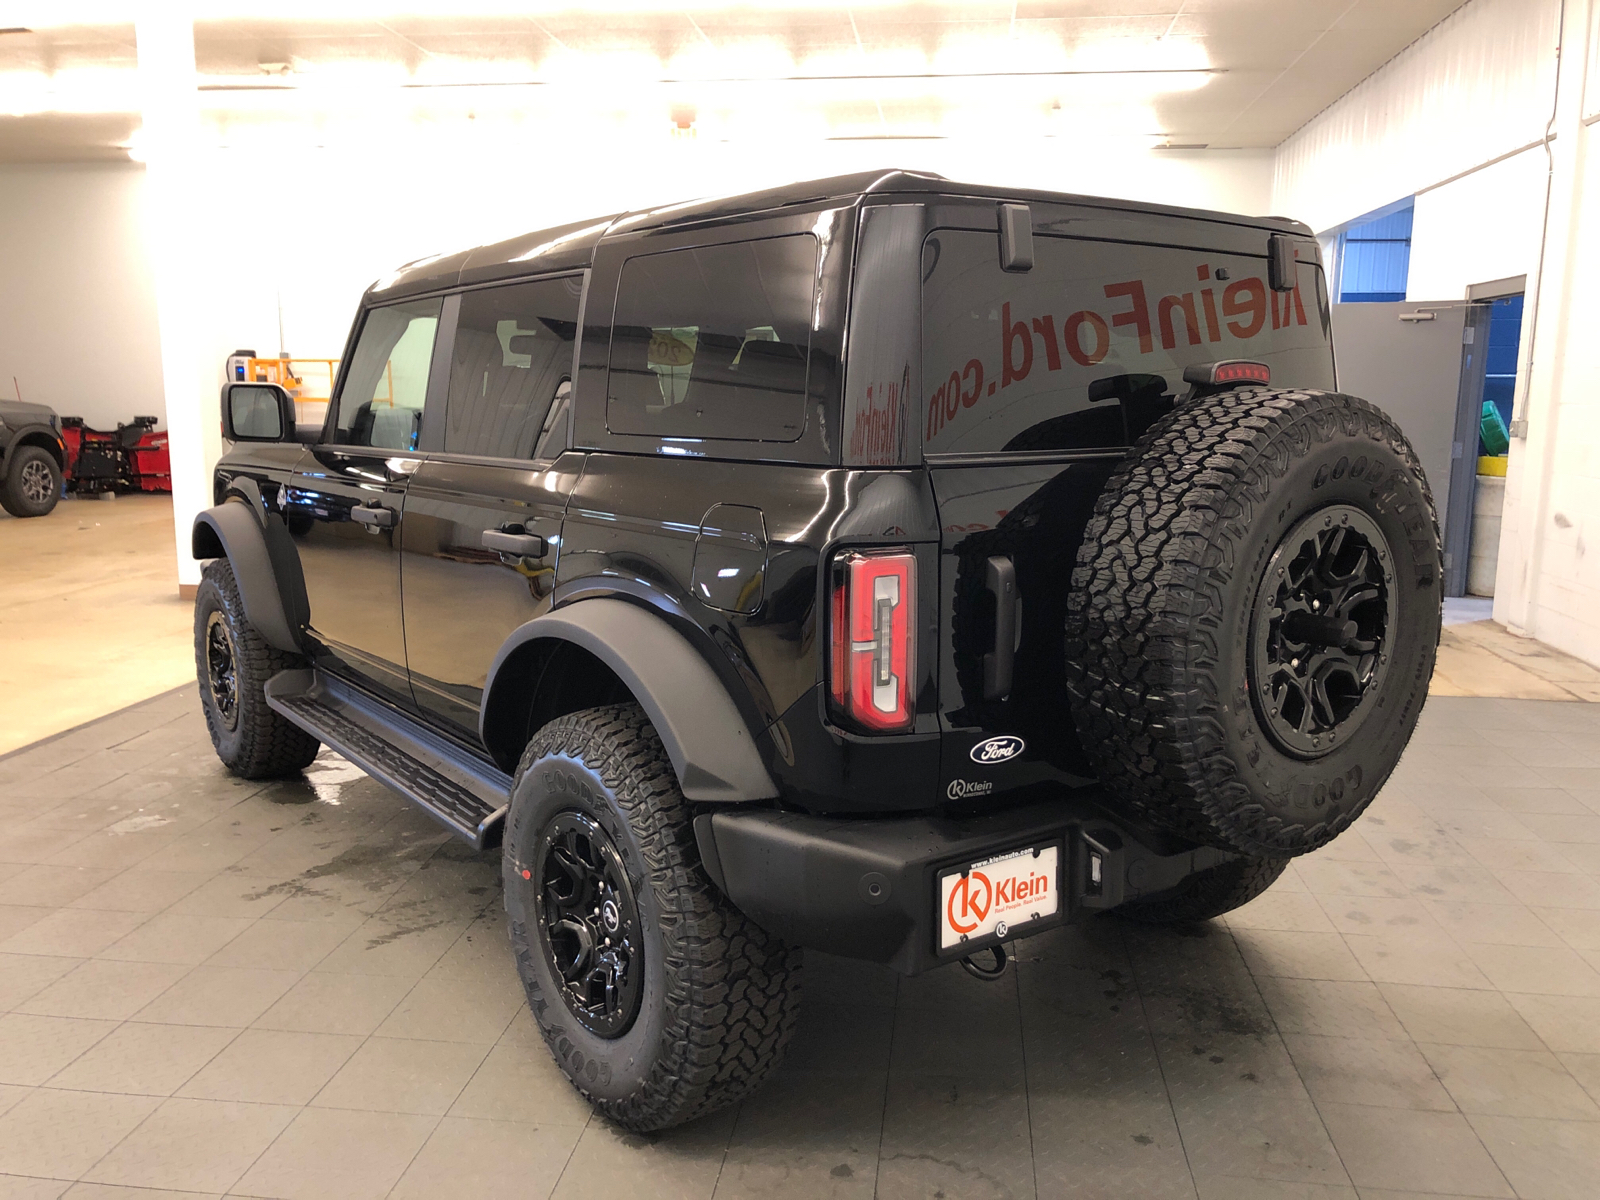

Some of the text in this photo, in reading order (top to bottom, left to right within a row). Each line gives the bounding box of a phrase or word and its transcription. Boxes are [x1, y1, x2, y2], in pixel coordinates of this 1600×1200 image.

[981, 740, 1015, 760] Ford
[966, 781, 993, 793] Klein
[971, 847, 1034, 869] www.kleinauto.com
[995, 871, 1048, 907] Klein
[994, 906, 1006, 914] Real
